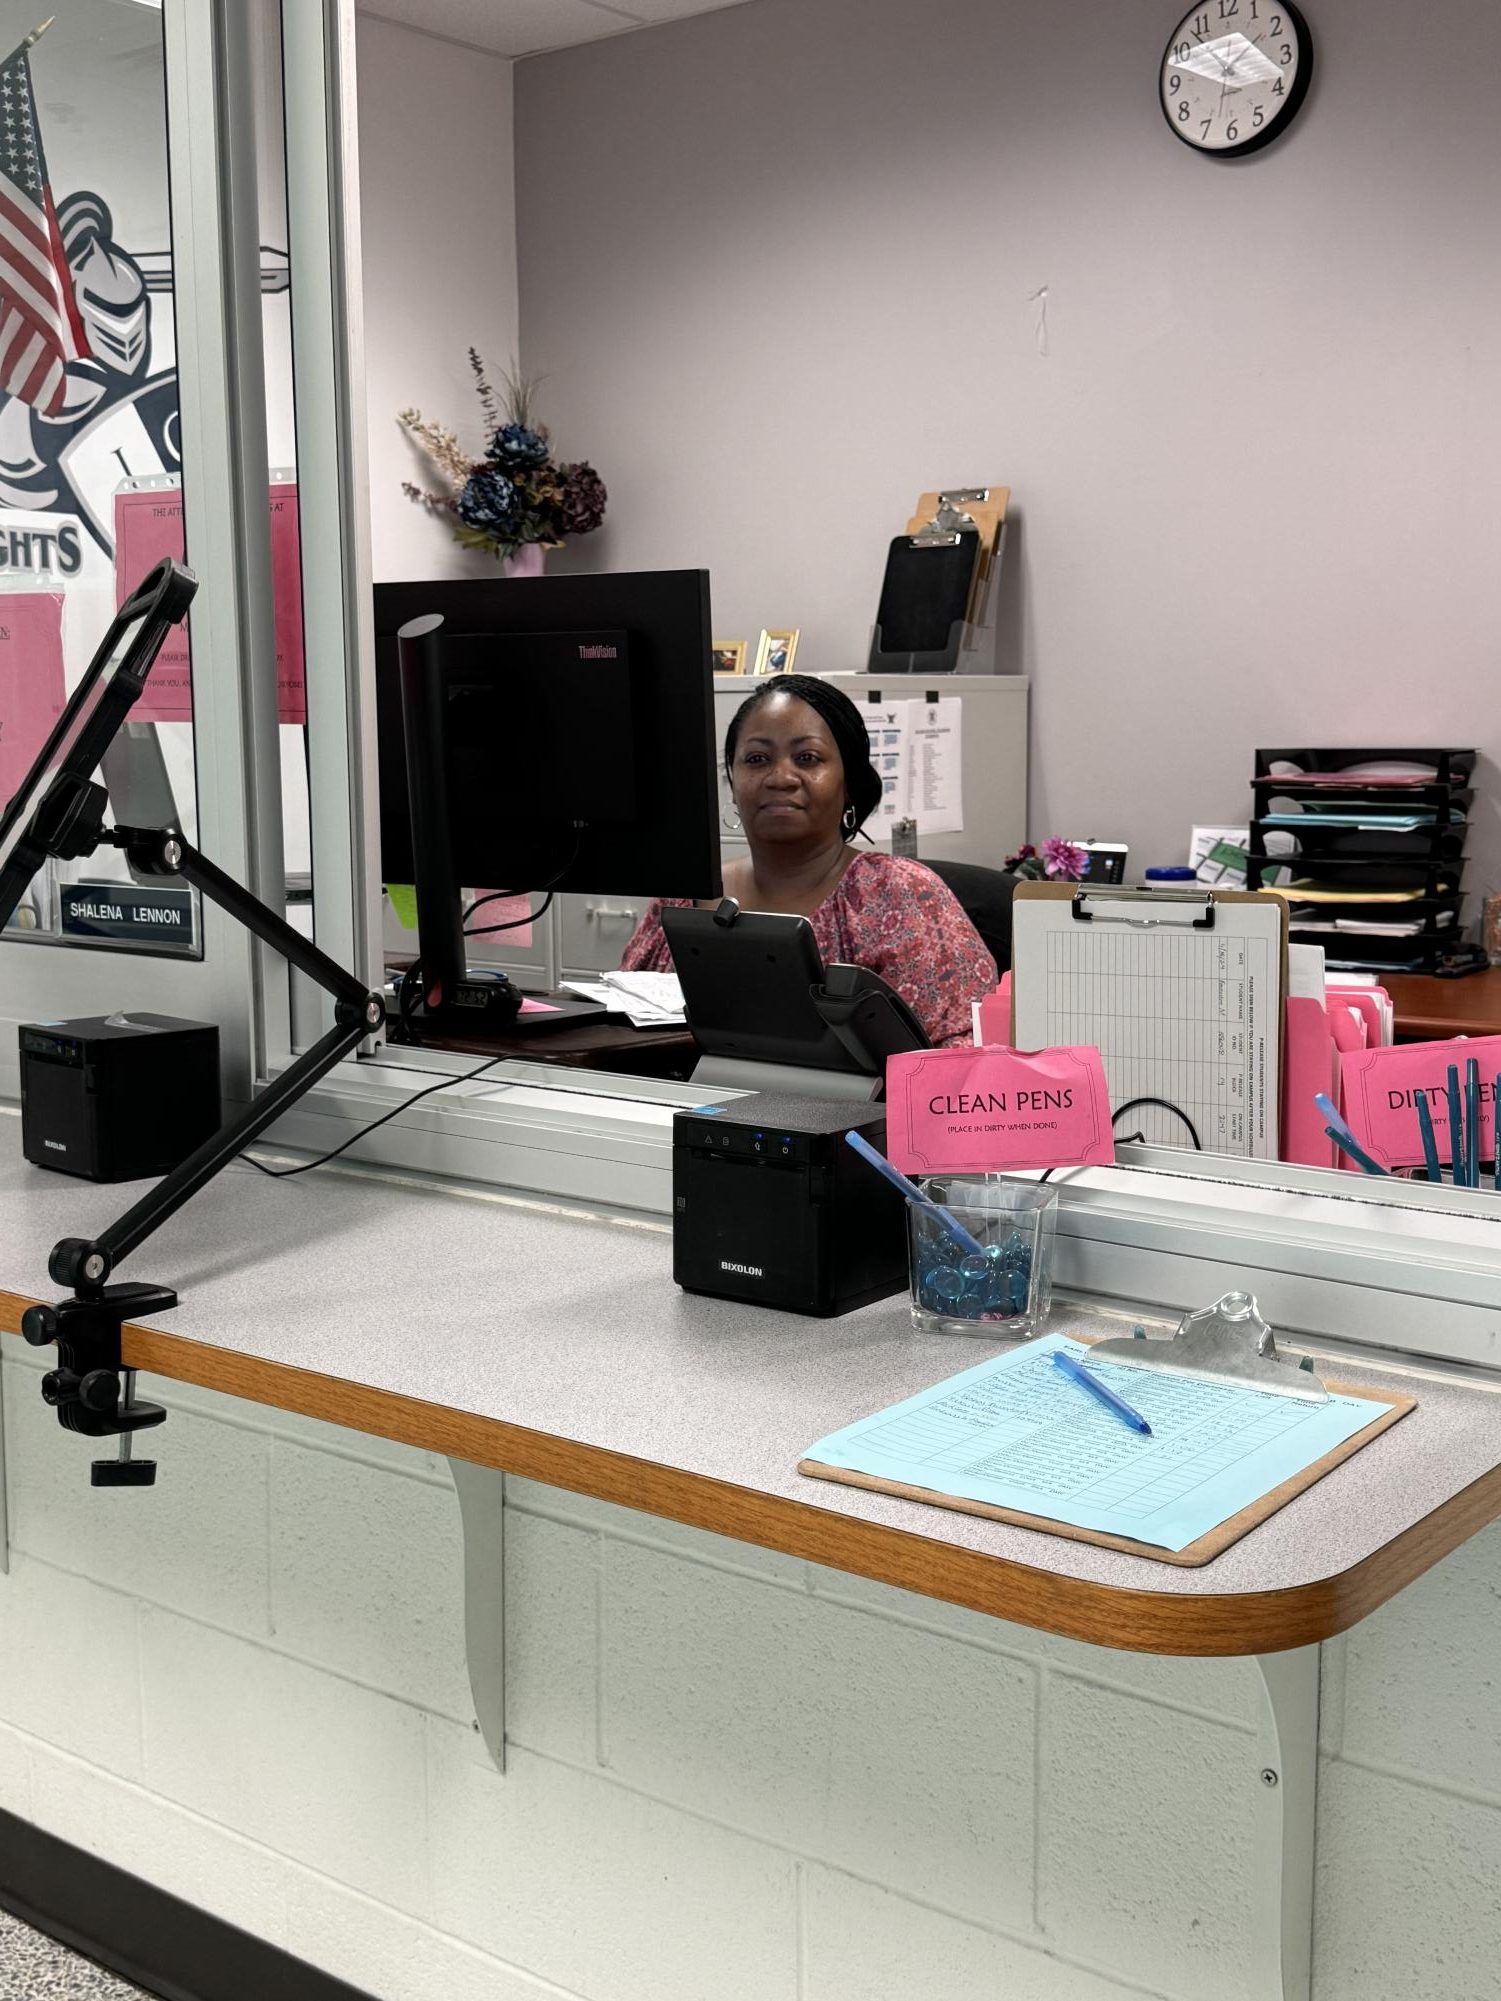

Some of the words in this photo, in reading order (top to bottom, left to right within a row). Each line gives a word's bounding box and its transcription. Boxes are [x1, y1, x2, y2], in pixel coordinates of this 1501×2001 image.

[1218, 0, 1239, 19] 12
[1251, 0, 1259, 20] 1
[1194, 13, 1210, 34] 11
[1270, 15, 1283, 37] 2
[1173, 42, 1191, 64] 10
[1280, 44, 1292, 65] 3
[1169, 75, 1181, 96] 9
[1271, 77, 1284, 96] 4
[1178, 101, 1190, 122] 8
[1253, 105, 1264, 127] 5
[1200, 119, 1212, 141] 7
[1226, 119, 1238, 141] 6
[578, 645, 617, 659] ThinkVision
[70, 902, 123, 921] SHALENA
[132, 906, 181, 925] LENNON
[929, 1093, 1006, 1115] CLEAN
[1016, 1089, 1073, 1111] PENS
[947, 1125, 973, 1134] (PLACE
[984, 1124, 1005, 1132] DIRTY
[1007, 1122, 1031, 1130] WHEN
[1033, 1121, 1058, 1130] DONE)
[720, 1261, 763, 1277] BIXOLON
